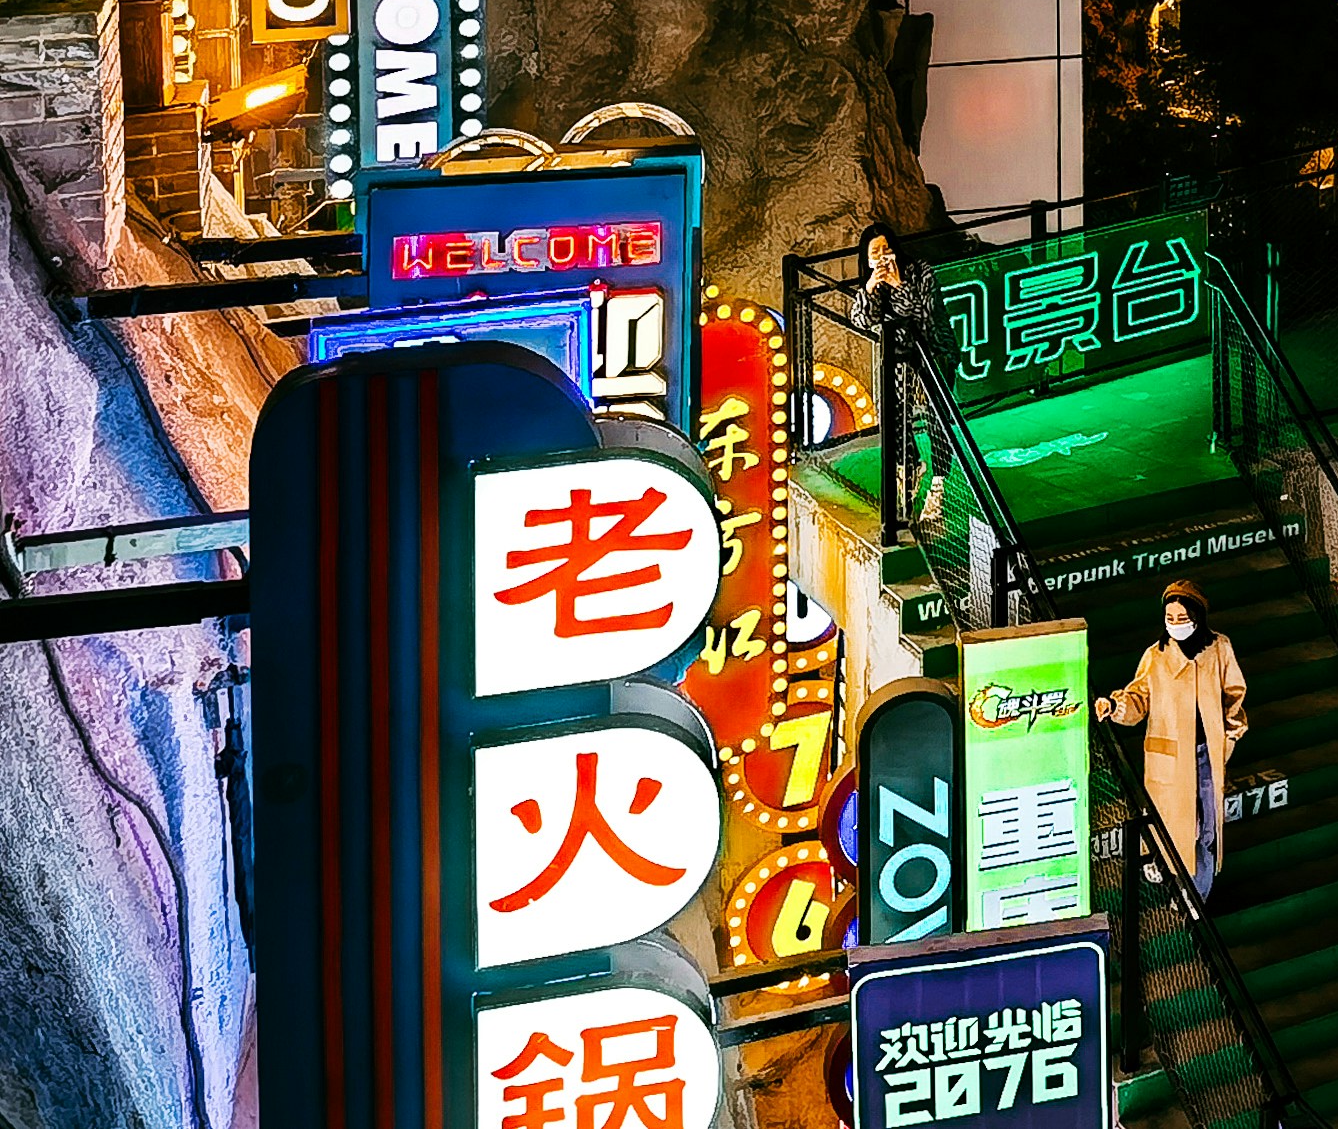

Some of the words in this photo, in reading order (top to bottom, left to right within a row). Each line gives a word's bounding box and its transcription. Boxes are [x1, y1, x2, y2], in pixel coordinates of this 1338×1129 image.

[399, 226, 659, 274] WELCOME
[1133, 539, 1201, 573] Trend
[489, 486, 693, 1129] 老火锅
[878, 776, 951, 945] ZO
[875, 997, 1082, 1072] 欢迎光临
[884, 1041, 1078, 1129] 2076
